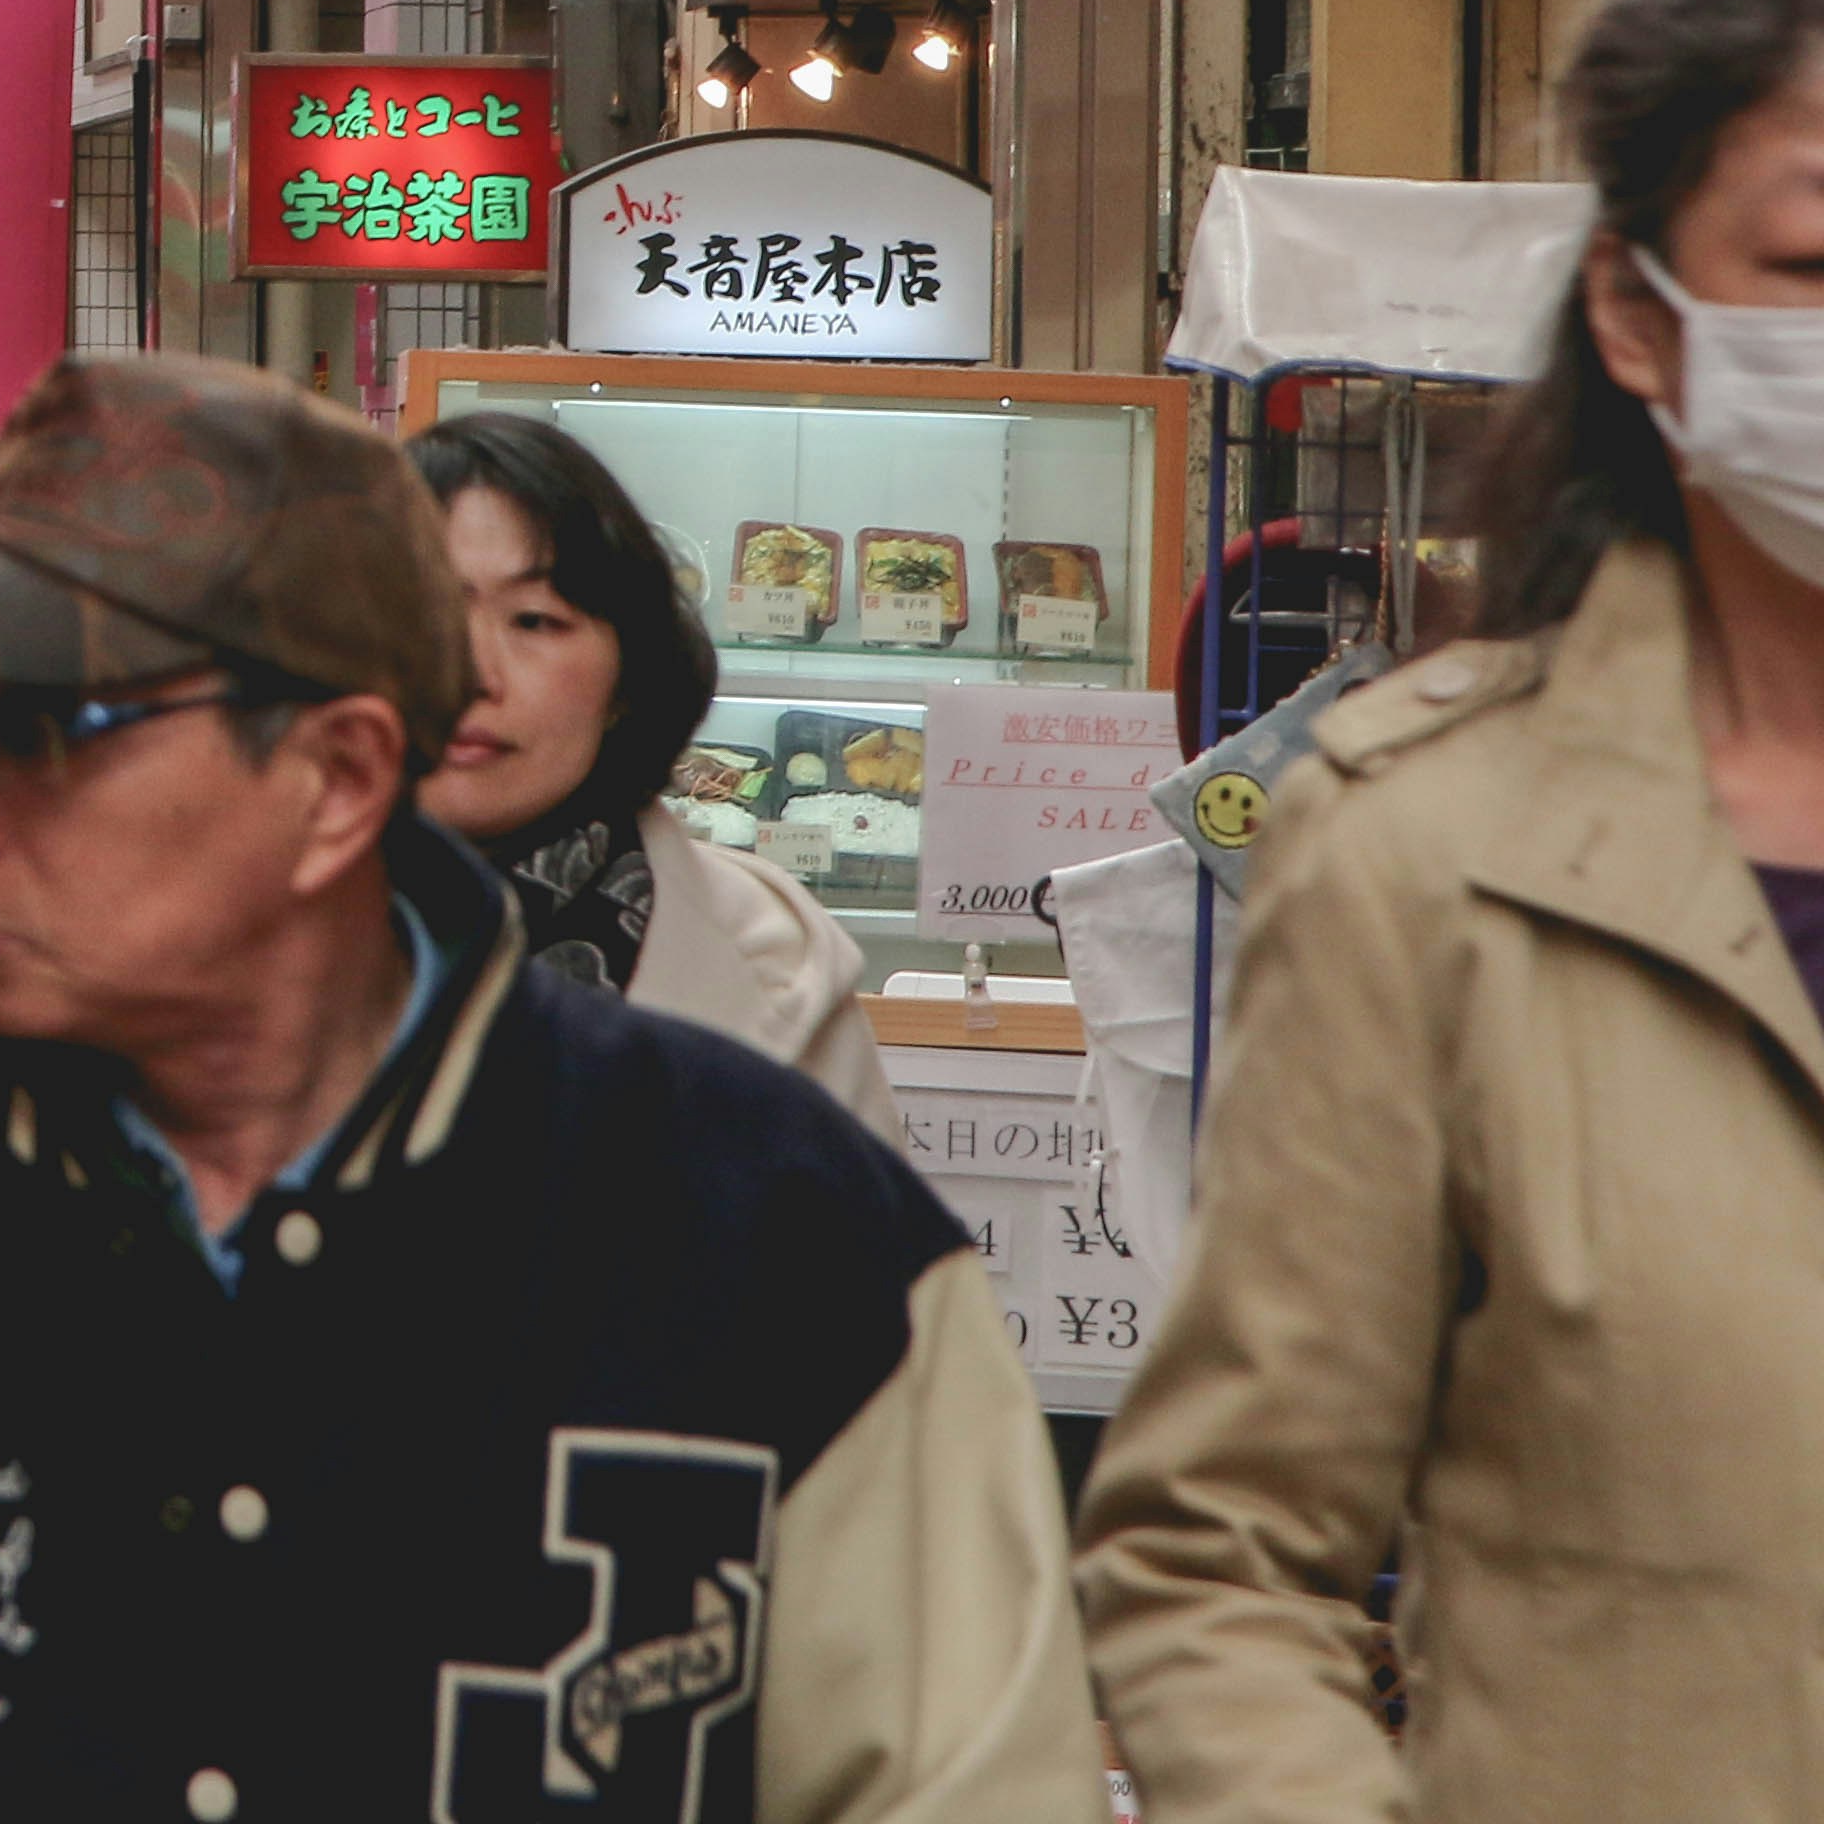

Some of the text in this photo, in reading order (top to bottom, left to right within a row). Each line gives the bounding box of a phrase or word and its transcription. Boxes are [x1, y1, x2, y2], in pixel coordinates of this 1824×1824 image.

[282, 168, 530, 247] 宇治茶園
[634, 231, 943, 307] 天音屋本店
[709, 308, 859, 337] AMANEYA
[949, 756, 1178, 788] Price d
[1036, 804, 1156, 833] SALE
